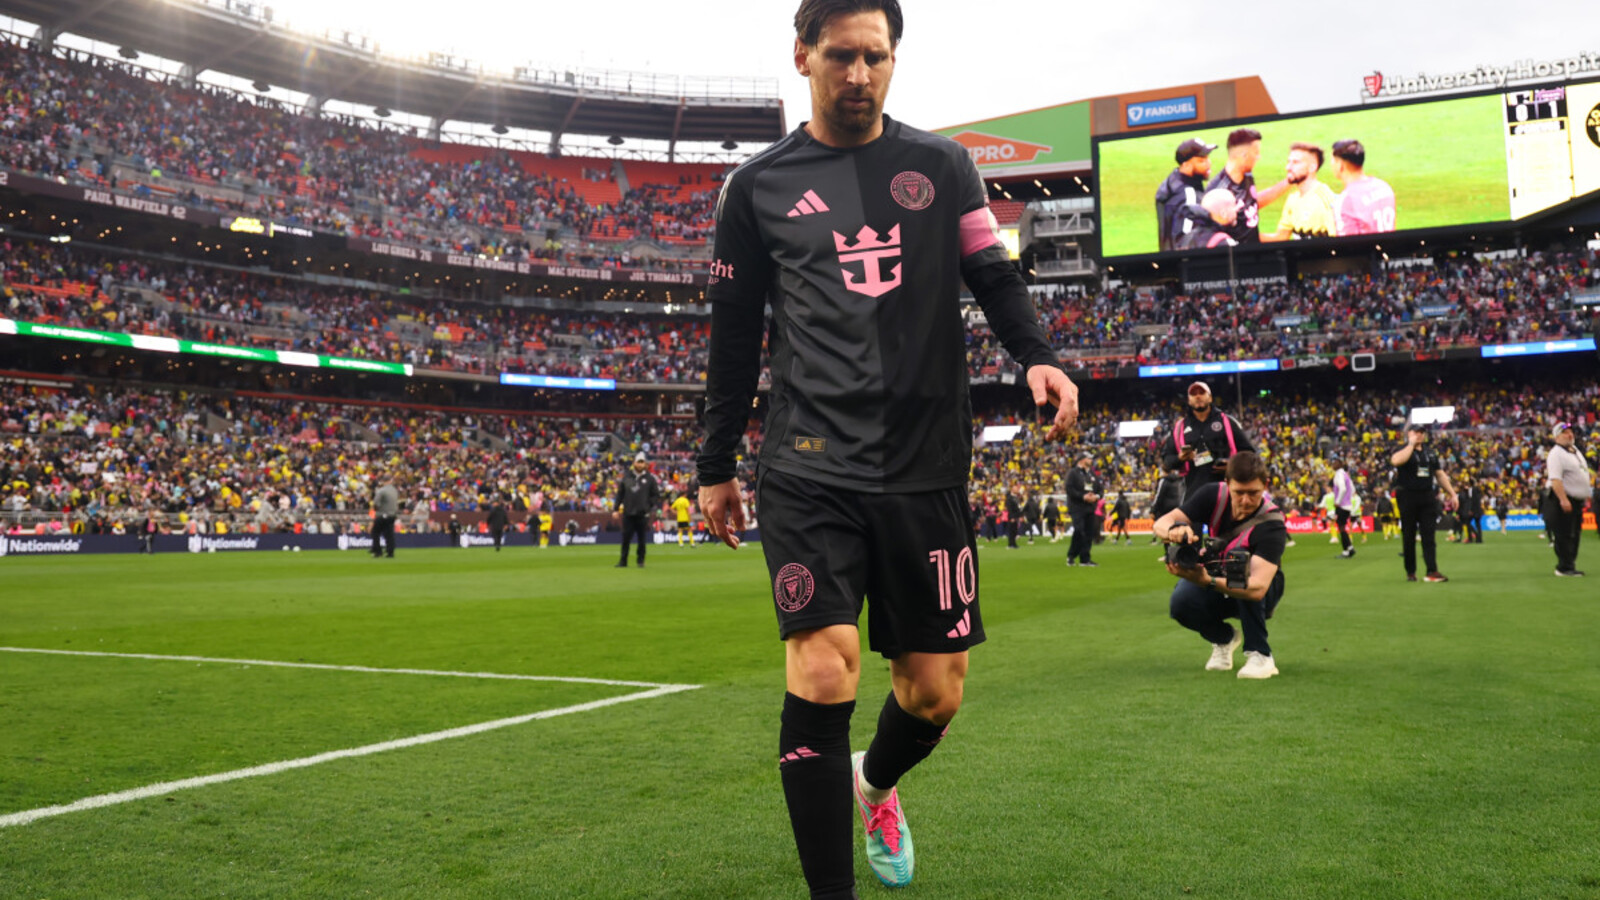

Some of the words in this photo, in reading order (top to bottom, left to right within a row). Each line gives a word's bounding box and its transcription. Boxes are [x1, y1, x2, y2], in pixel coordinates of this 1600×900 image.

[1386, 64, 1508, 95] University
[1516, 51, 1600, 80] Hospit
[1145, 103, 1195, 117] FANDUEL
[1516, 104, 1528, 121] 0
[1549, 100, 1558, 118] 1
[84, 189, 113, 204] PAUL
[115, 195, 168, 215] WARFIELD
[171, 206, 186, 219] 42
[710, 258, 734, 280] cht
[629, 272, 645, 282] JOE
[647, 272, 681, 283] THOMAS
[681, 273, 693, 284] 73
[1285, 520, 1312, 530] Audi
[9, 539, 80, 552] Nationwide
[203, 537, 257, 549] Nationwide
[929, 545, 976, 611] 10
